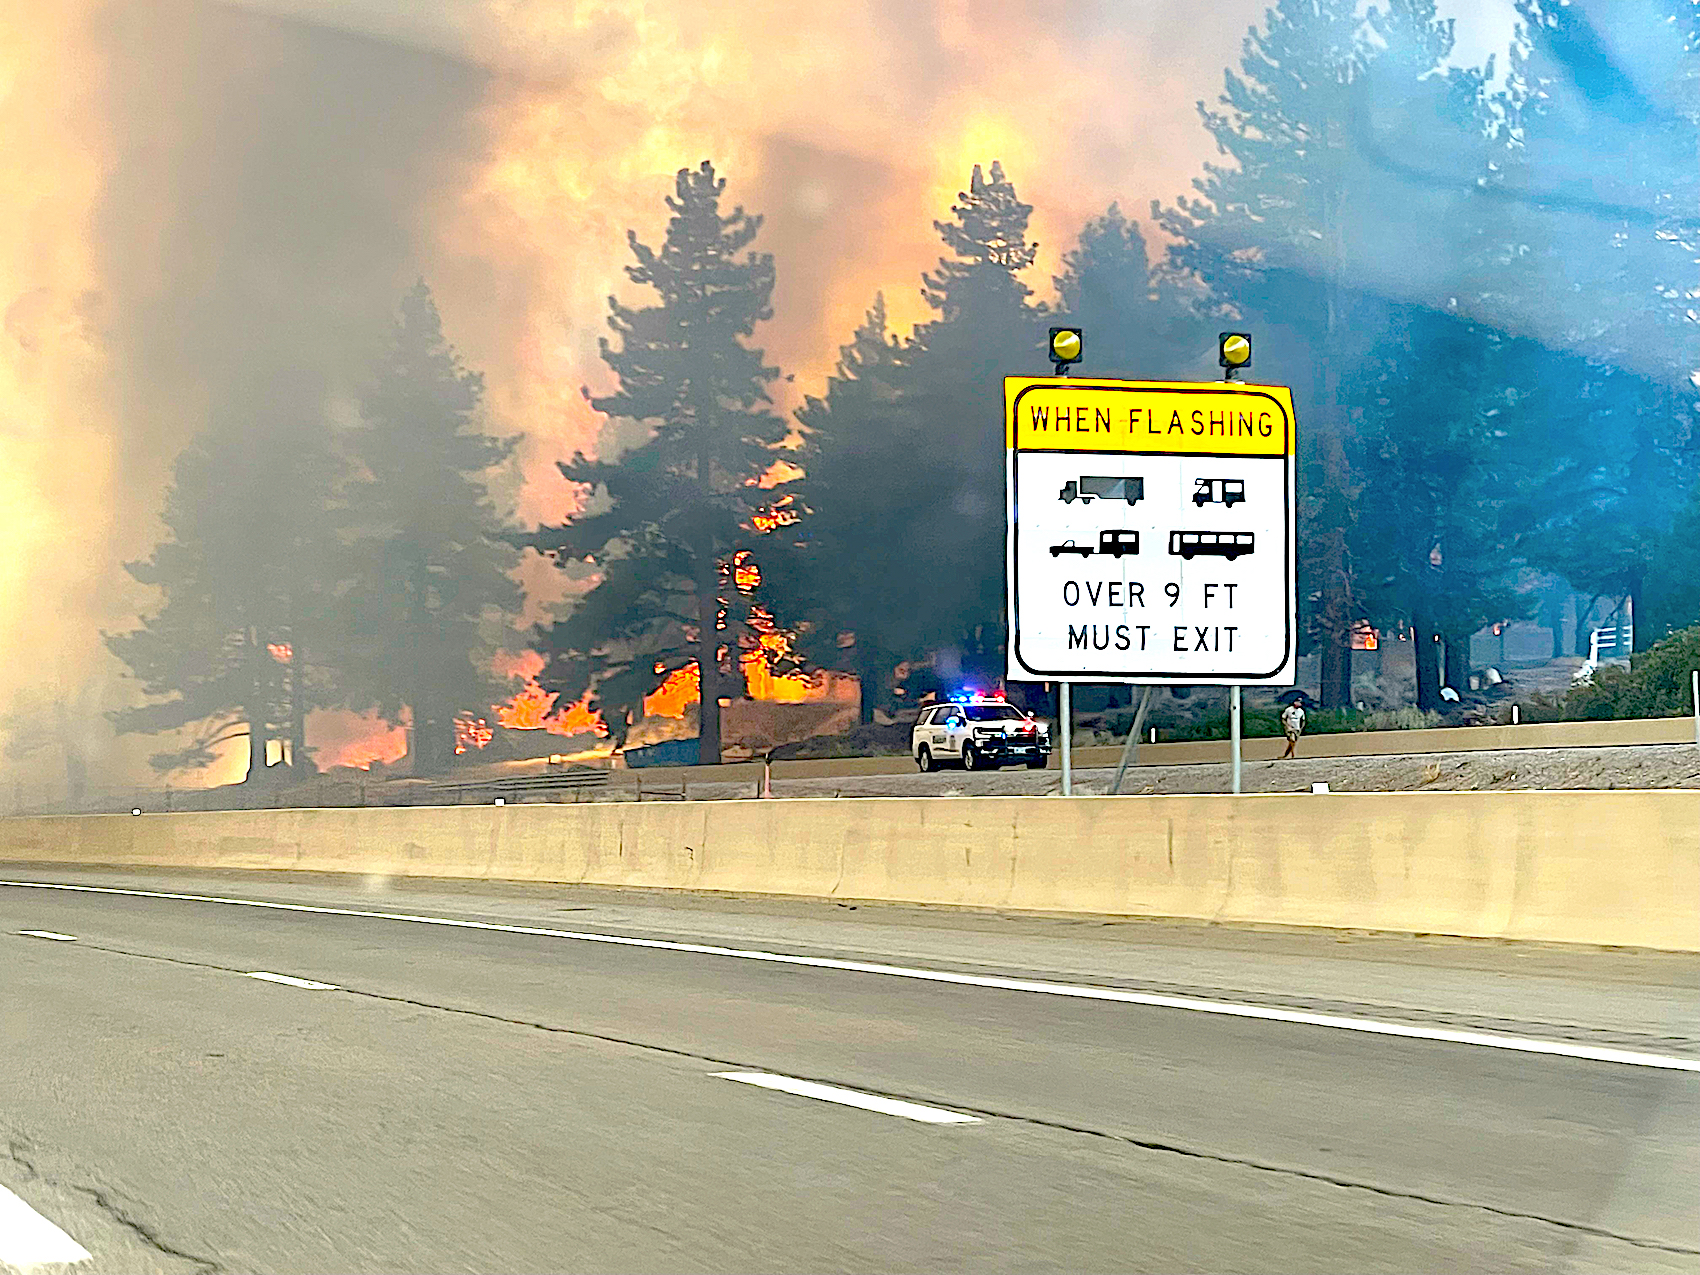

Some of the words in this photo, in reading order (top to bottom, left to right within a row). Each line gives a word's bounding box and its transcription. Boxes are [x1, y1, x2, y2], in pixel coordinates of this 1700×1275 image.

[1031, 406, 1111, 433] WHEN
[1129, 409, 1273, 437] FLASHING
[1063, 581, 1145, 607] OVER
[1164, 583, 1180, 607] 9
[1204, 584, 1238, 608] FT
[1068, 625, 1151, 650] MUST
[1173, 627, 1238, 652] EXIT
